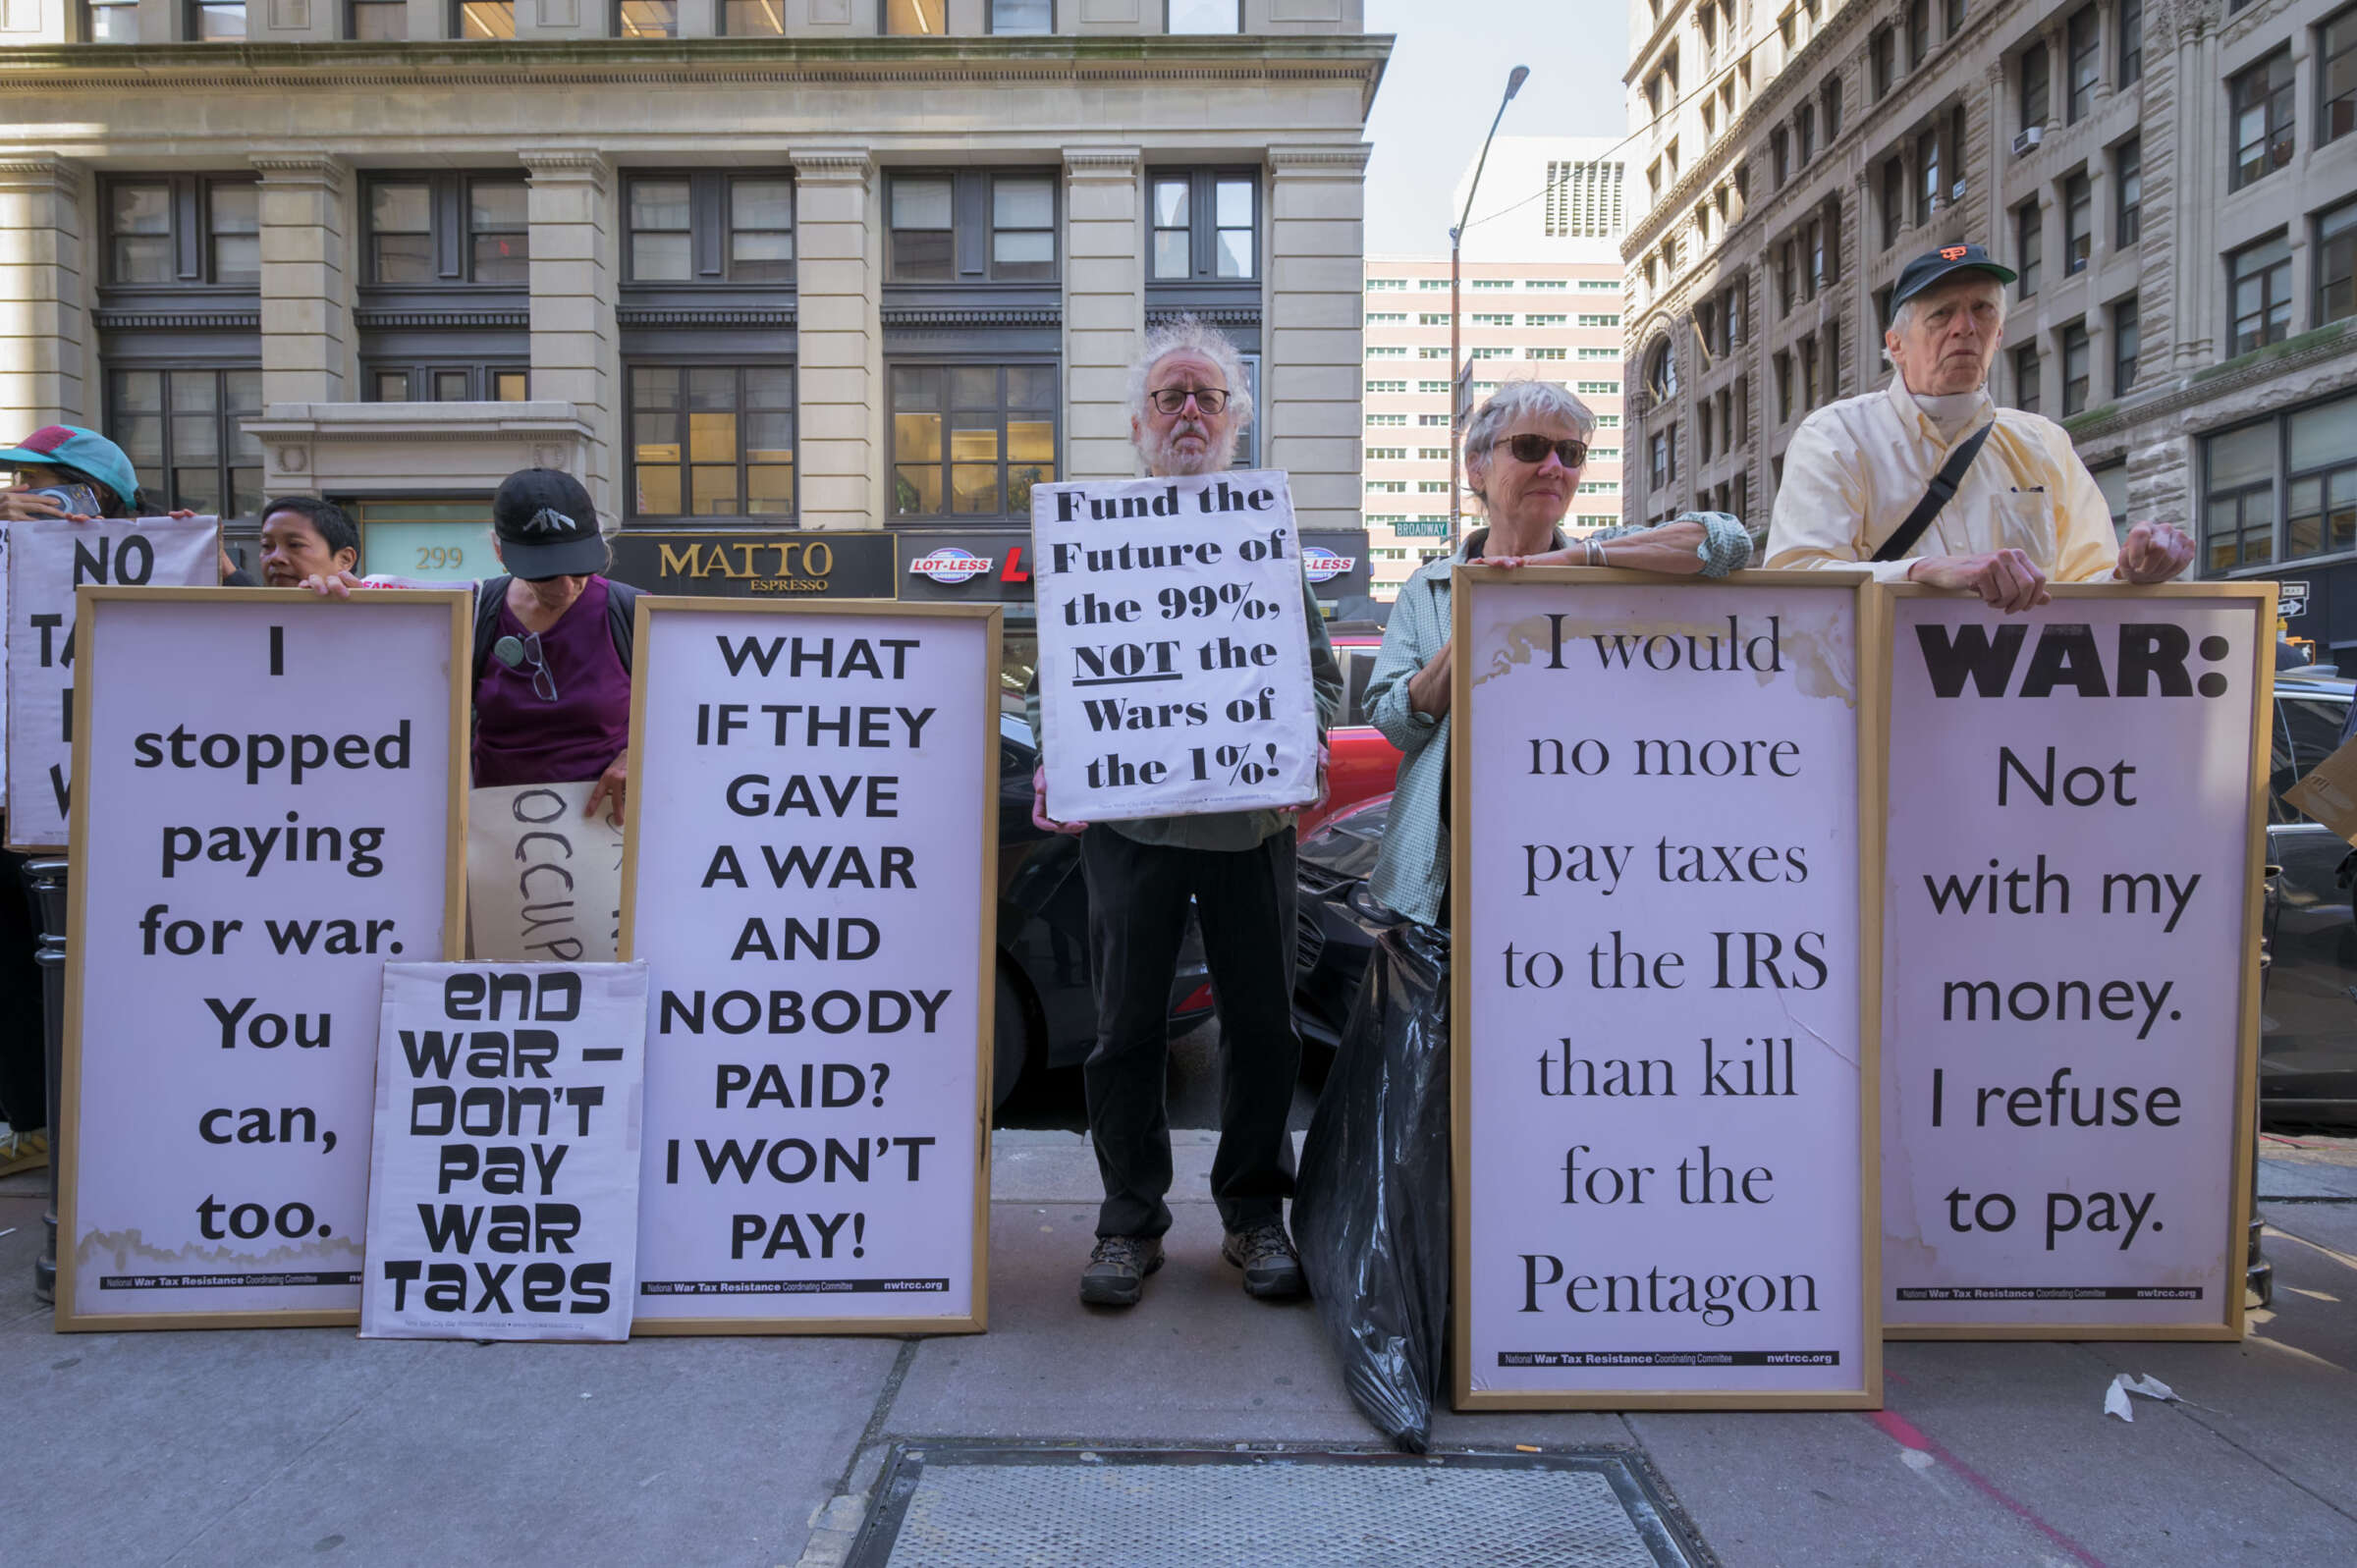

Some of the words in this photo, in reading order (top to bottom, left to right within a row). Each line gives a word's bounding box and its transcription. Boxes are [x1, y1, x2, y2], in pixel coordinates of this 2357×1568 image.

[1056, 485, 1179, 522] Fund
[1197, 481, 1274, 514] the
[1053, 542, 1223, 574] Future
[1238, 528, 1287, 562] of
[1397, 523, 1445, 536] BROADWAY
[74, 534, 154, 591] NO
[416, 546, 463, 569] 299
[658, 542, 833, 577] MATTO
[913, 560, 989, 570] LOT-LESS
[1303, 559, 1351, 569] -LESS
[750, 580, 828, 591] ESPRESSO
[1064, 593, 1141, 626] the
[1158, 581, 1282, 622] 99%,
[269, 625, 284, 676] I
[716, 635, 920, 679] WHAT
[1071, 639, 1181, 680] NOT
[1197, 636, 1278, 671] the
[1545, 614, 1567, 670] I
[1590, 615, 1784, 673] would
[1913, 622, 2229, 699] WAR:
[696, 704, 748, 745] IF
[761, 705, 937, 748] THEY
[1082, 698, 1208, 731] Wars
[1226, 686, 1275, 723] of
[135, 719, 411, 785] stopped
[1086, 753, 1167, 788] the
[1188, 742, 1280, 786] 1%!
[1529, 738, 1610, 775] no
[1634, 739, 1800, 778] more
[726, 774, 899, 818] GAVE
[1998, 745, 2137, 807] Not
[162, 810, 385, 879] paying
[701, 845, 748, 889] A
[760, 845, 917, 889] WAR
[1522, 844, 1633, 896] pay
[1657, 837, 1808, 883] taxes
[1922, 854, 2070, 915] with
[2102, 873, 2202, 934] my
[138, 903, 244, 955] for
[264, 919, 404, 955] war.
[730, 917, 881, 961] AND
[1503, 942, 1563, 989] to
[1589, 930, 1684, 989] the
[1713, 932, 1828, 991] IRS
[203, 998, 331, 1050] You
[659, 989, 953, 1035] NOBODY
[1943, 980, 2181, 1040] money.
[716, 1062, 890, 1108] PAID?
[1537, 1038, 1676, 1097] than
[1701, 1038, 1797, 1096] kill
[1932, 1067, 1944, 1127] I
[1976, 1066, 2181, 1127] refuse
[198, 1107, 337, 1155] can,
[666, 1139, 680, 1184] I
[694, 1136, 936, 1185] WON'T
[1562, 1145, 1655, 1204] for
[1677, 1145, 1774, 1205] the
[195, 1193, 332, 1240] too.
[731, 1212, 865, 1260] PAY!
[1944, 1186, 2016, 1233] to
[2046, 1191, 2164, 1251] pay.
[135, 1277, 156, 1286] War
[159, 1276, 179, 1286] Tax
[182, 1275, 244, 1286] Resistance
[674, 1283, 695, 1292] War
[698, 1282, 717, 1292] Tax
[720, 1282, 782, 1291] Resistance
[884, 1280, 943, 1291] nwtrcc.org
[1518, 1254, 1820, 1326] Pentagon
[1929, 1289, 1949, 1298] War
[1952, 1289, 1972, 1298] Tax
[1974, 1289, 2035, 1298] Resistance
[2137, 1289, 2197, 1299] nwtrcc.org
[1534, 1354, 1558, 1364] War
[1561, 1354, 1582, 1364] Tax
[1586, 1354, 1653, 1364] Resistance
[1767, 1354, 1833, 1365] nwtrcc.org
